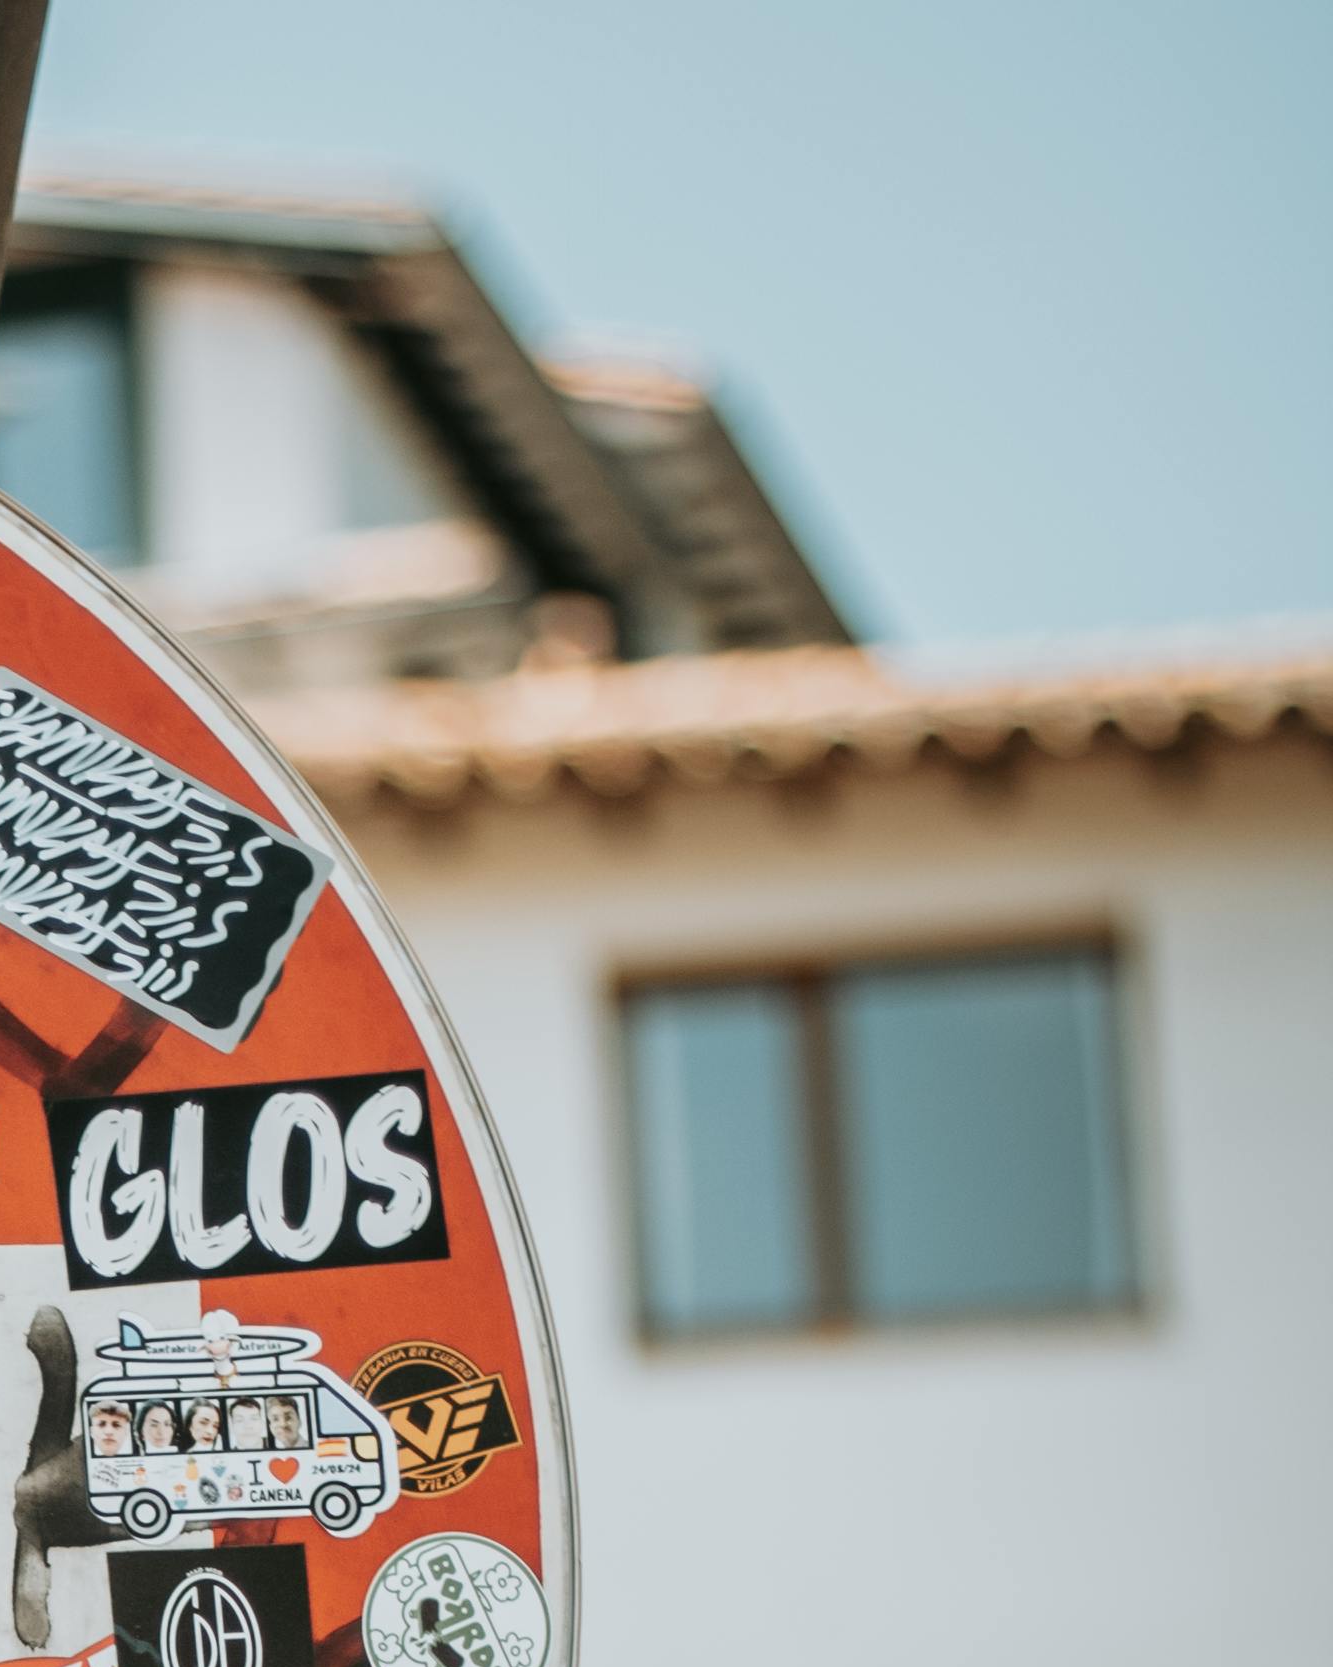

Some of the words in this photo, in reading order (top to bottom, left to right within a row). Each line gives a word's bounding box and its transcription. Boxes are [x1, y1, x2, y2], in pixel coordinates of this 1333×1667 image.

[70, 1084, 432, 1279] GLOS
[355, 1348, 407, 1393] TESANIA
[248, 1460, 263, 1486] I
[249, 1488, 303, 1504] CANENA
